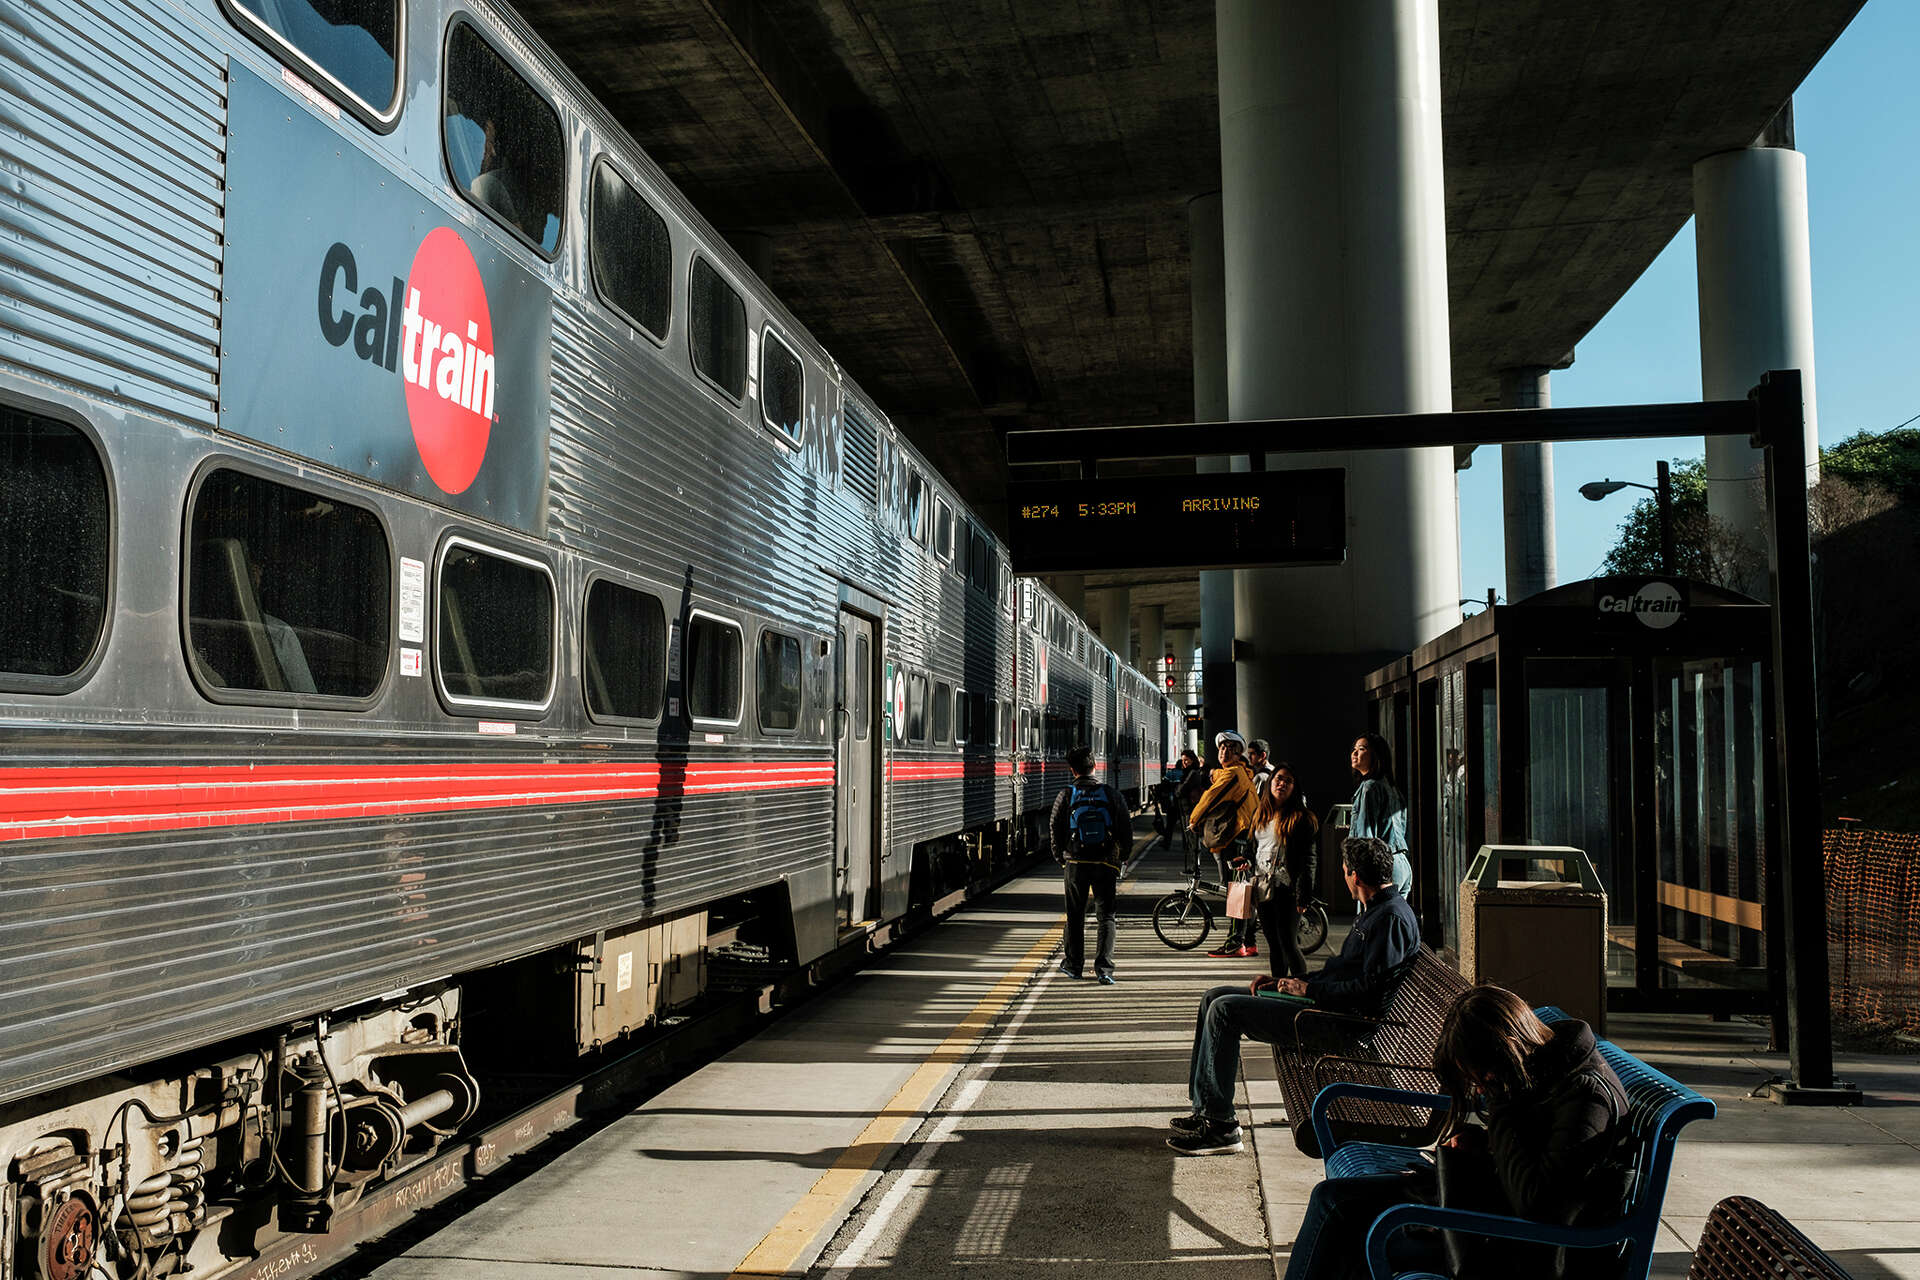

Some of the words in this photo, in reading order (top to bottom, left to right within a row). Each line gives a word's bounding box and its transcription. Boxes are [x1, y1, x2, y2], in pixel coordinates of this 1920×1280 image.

[318, 241, 496, 421] Caltrain
[1022, 505, 1059, 519] #274
[1078, 501, 1136, 517] 5:33PM
[1182, 496, 1260, 512] ARRIVING
[1599, 595, 1682, 613] Caltrain
